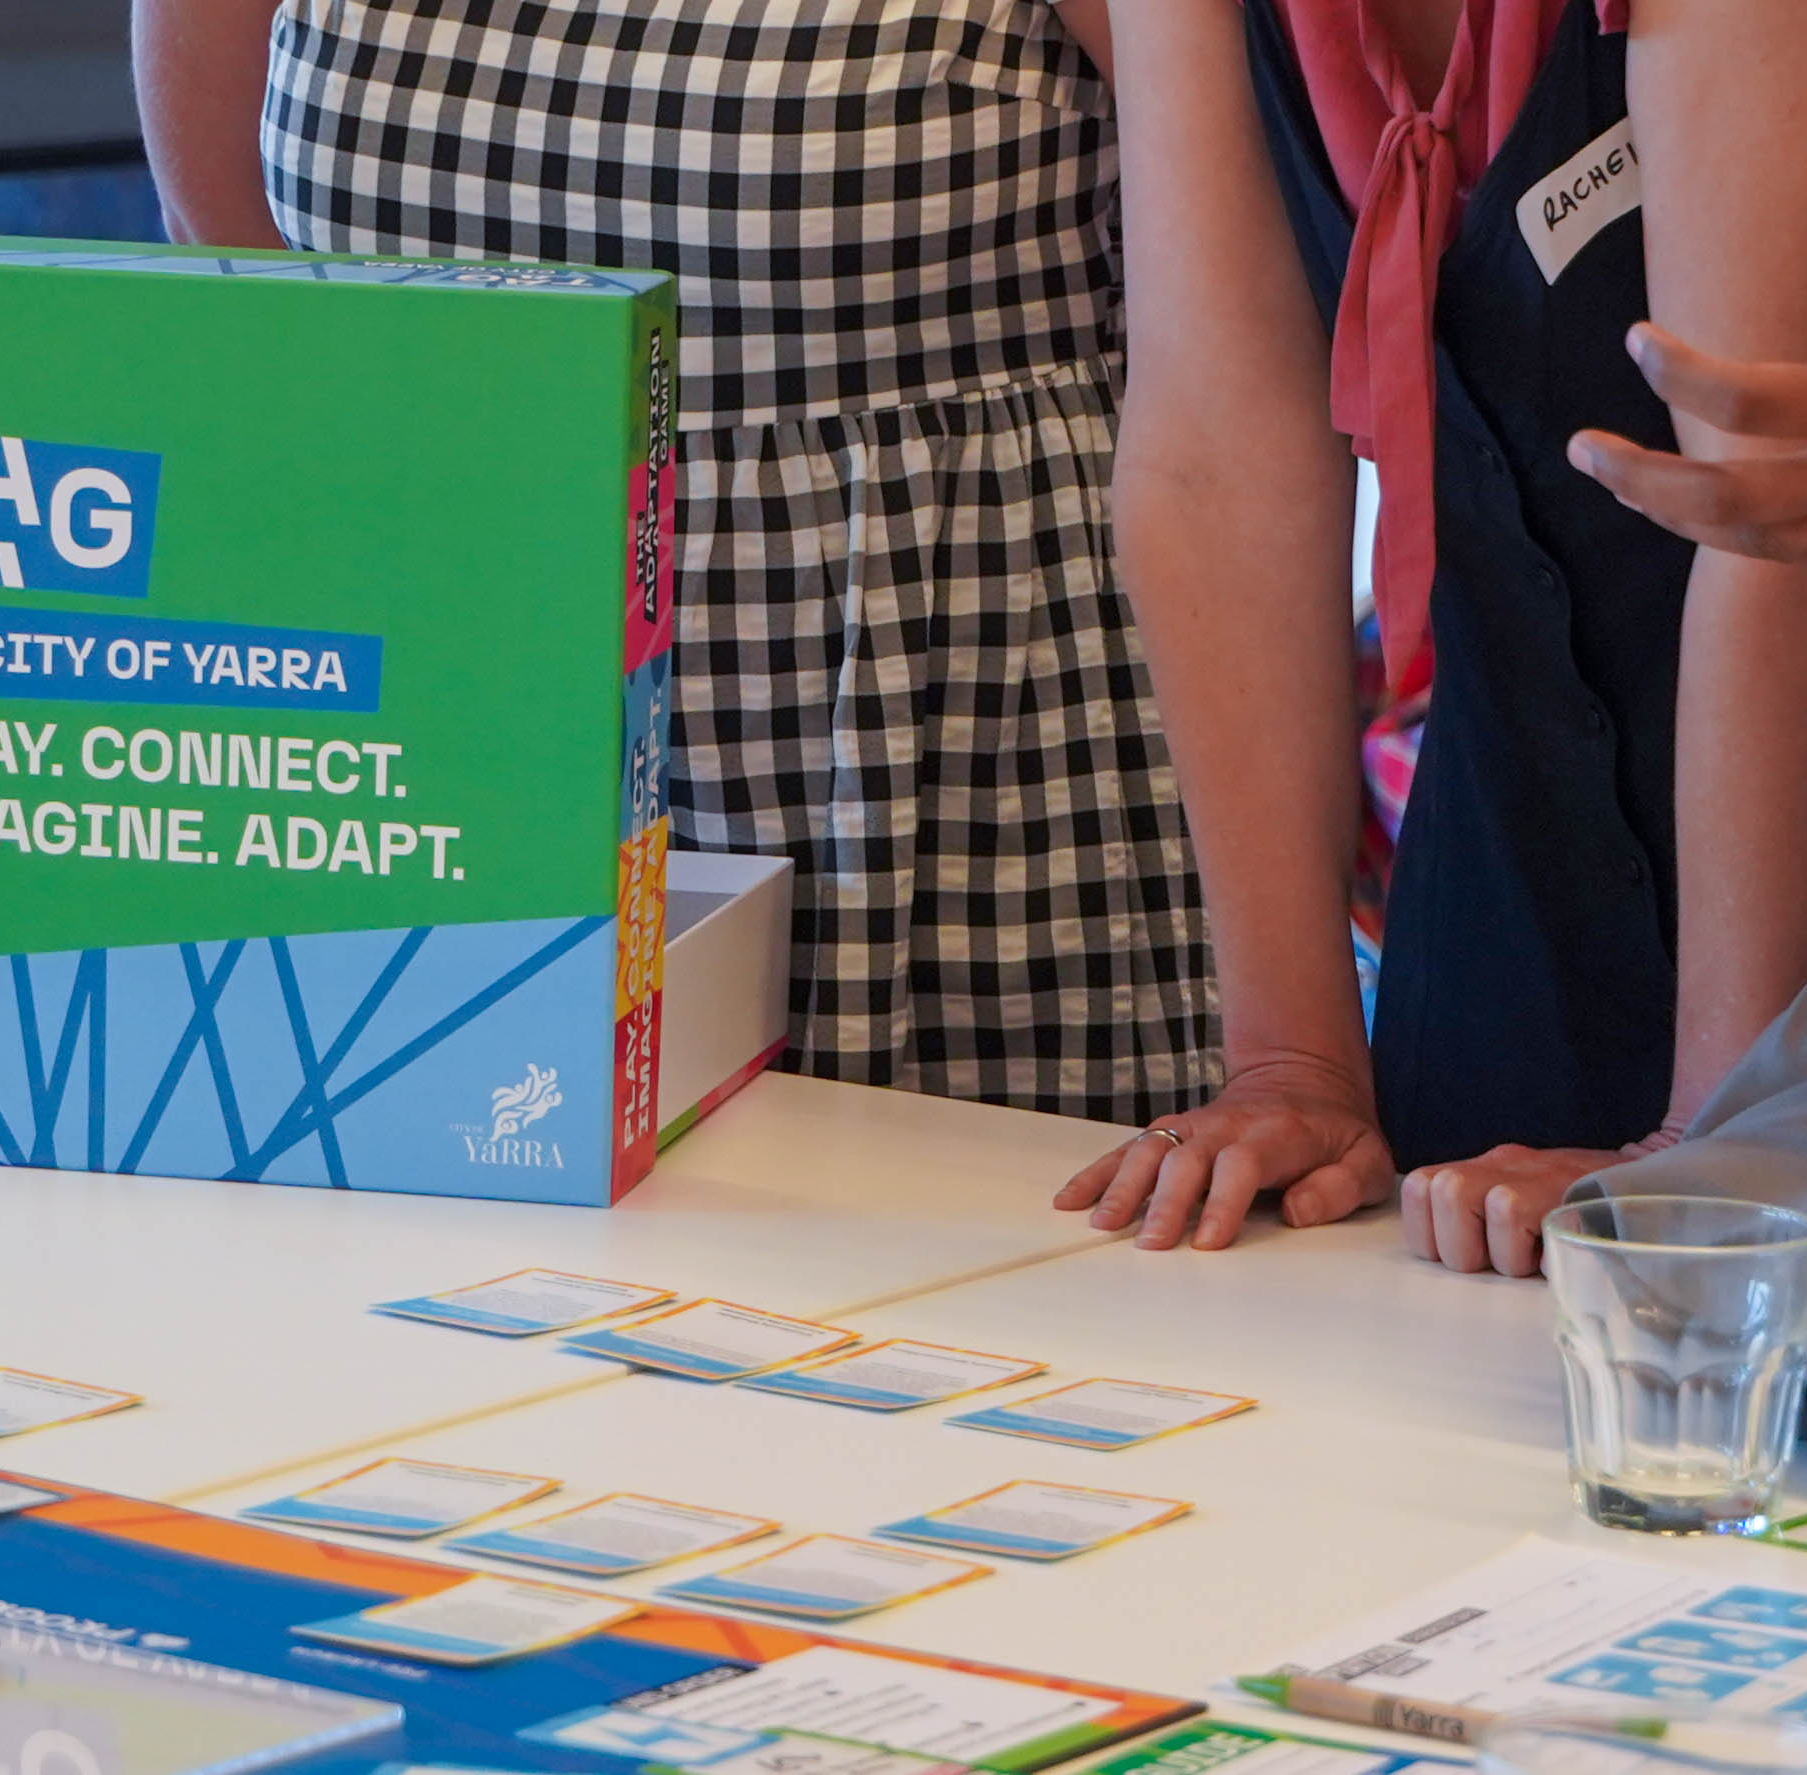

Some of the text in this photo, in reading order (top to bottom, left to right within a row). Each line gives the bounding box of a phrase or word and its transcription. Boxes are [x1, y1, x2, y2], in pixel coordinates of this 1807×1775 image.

[659, 365, 670, 463] GAME
[643, 335, 661, 616] ADAPTATION
[106, 638, 171, 682] OF
[183, 643, 347, 692] YARRA
[81, 725, 407, 798] CONNECT.
[646, 687, 663, 867] ADAPT.
[235, 813, 466, 881] ADAPT.
[623, 737, 645, 1150] PLAY. CONNECT.
